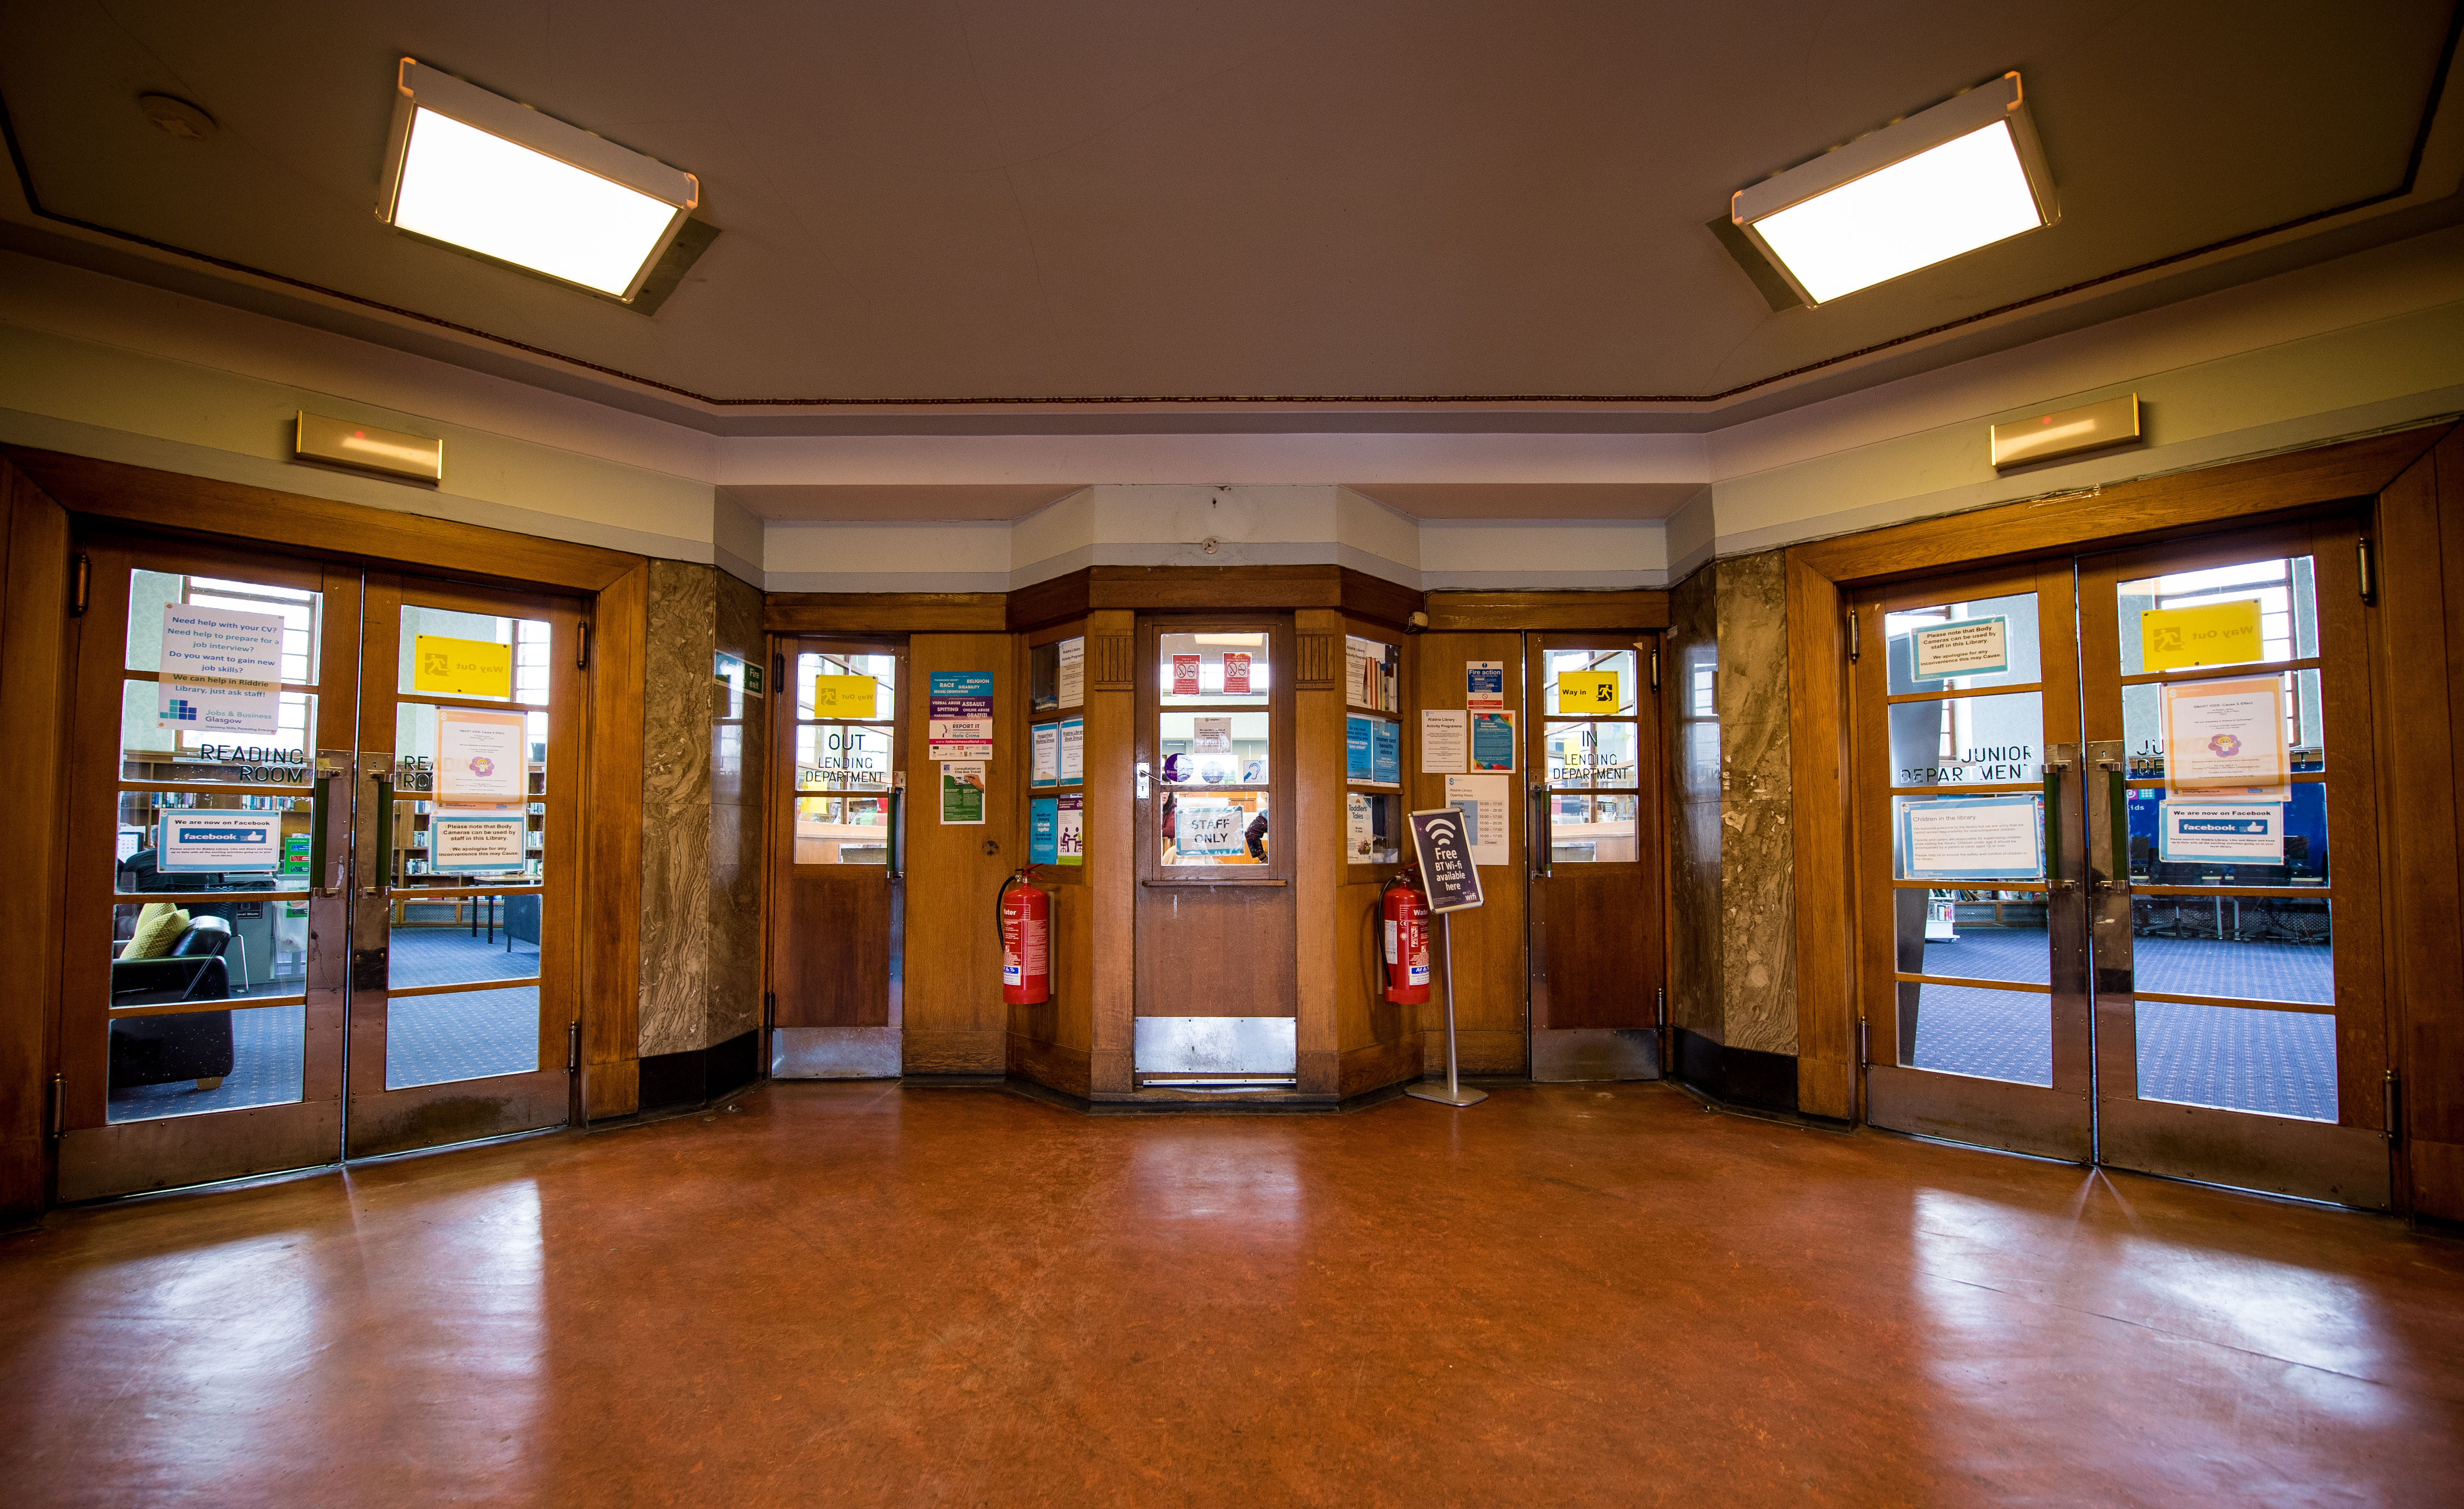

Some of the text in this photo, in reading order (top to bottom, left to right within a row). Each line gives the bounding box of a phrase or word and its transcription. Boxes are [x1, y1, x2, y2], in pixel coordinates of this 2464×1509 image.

[226, 634, 258, 643] prepare
[210, 643, 254, 652] interview?
[750, 668, 759, 679] Fire
[175, 685, 207, 694] Library,
[749, 681, 759, 689] exit
[206, 716, 242, 724] Glasgow
[829, 734, 865, 750] OUT
[1582, 731, 1598, 746] IN
[201, 744, 304, 764] READING
[1962, 746, 2034, 763] JUNIOR
[819, 757, 872, 769] LENDING
[1565, 754, 1617, 766] LENDING
[240, 765, 302, 783] ROOM
[806, 771, 884, 782] DEPARTMENT
[1554, 768, 1628, 780] DEPARTMENT
[1191, 819, 1230, 829] STAFF
[1195, 833, 1228, 843] ONLY
[1435, 848, 1457, 860] Free
[1435, 861, 1462, 871] BT Wi-fi
[1436, 871, 1465, 882] available
[1445, 882, 1461, 891] here
